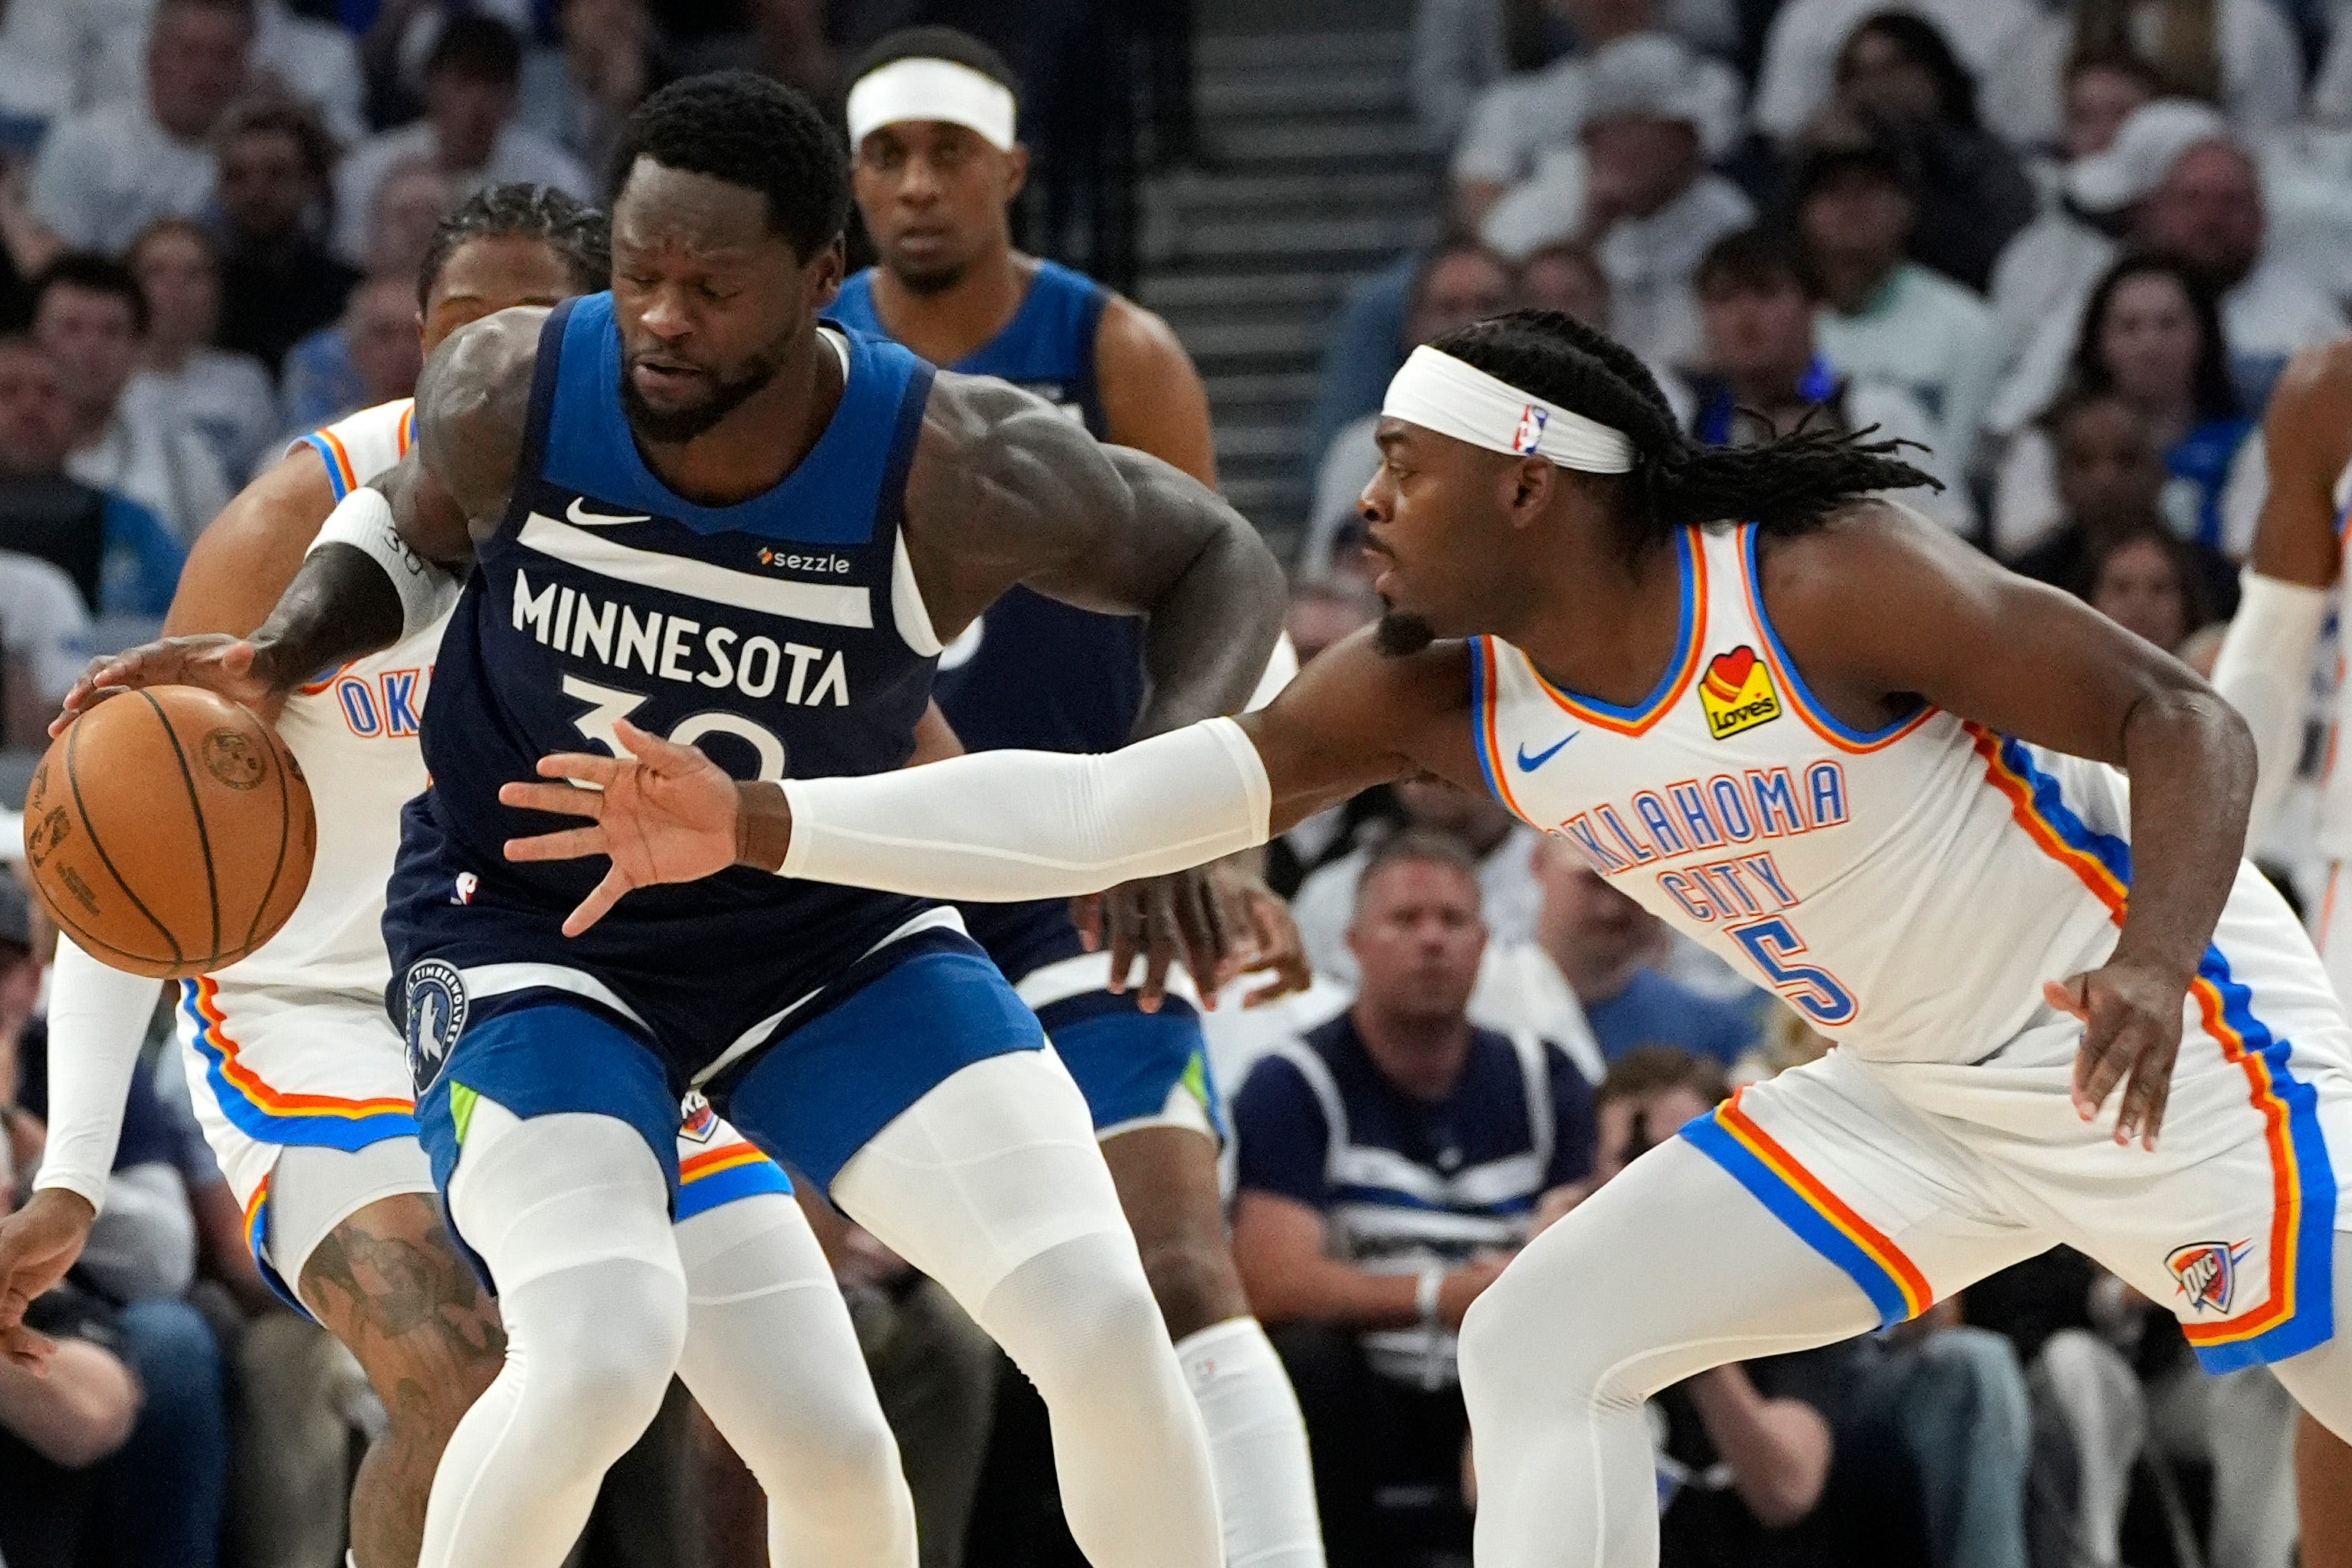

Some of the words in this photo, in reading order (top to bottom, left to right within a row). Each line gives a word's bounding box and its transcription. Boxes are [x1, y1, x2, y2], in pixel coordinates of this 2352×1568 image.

[773, 553, 850, 573] sezzle
[512, 568, 850, 707] MINNESOTA
[336, 665, 435, 739] OK
[1547, 759, 1849, 876] KLAHOMA
[1656, 850, 1799, 922] CITY
[1723, 914, 1858, 1027] 5
